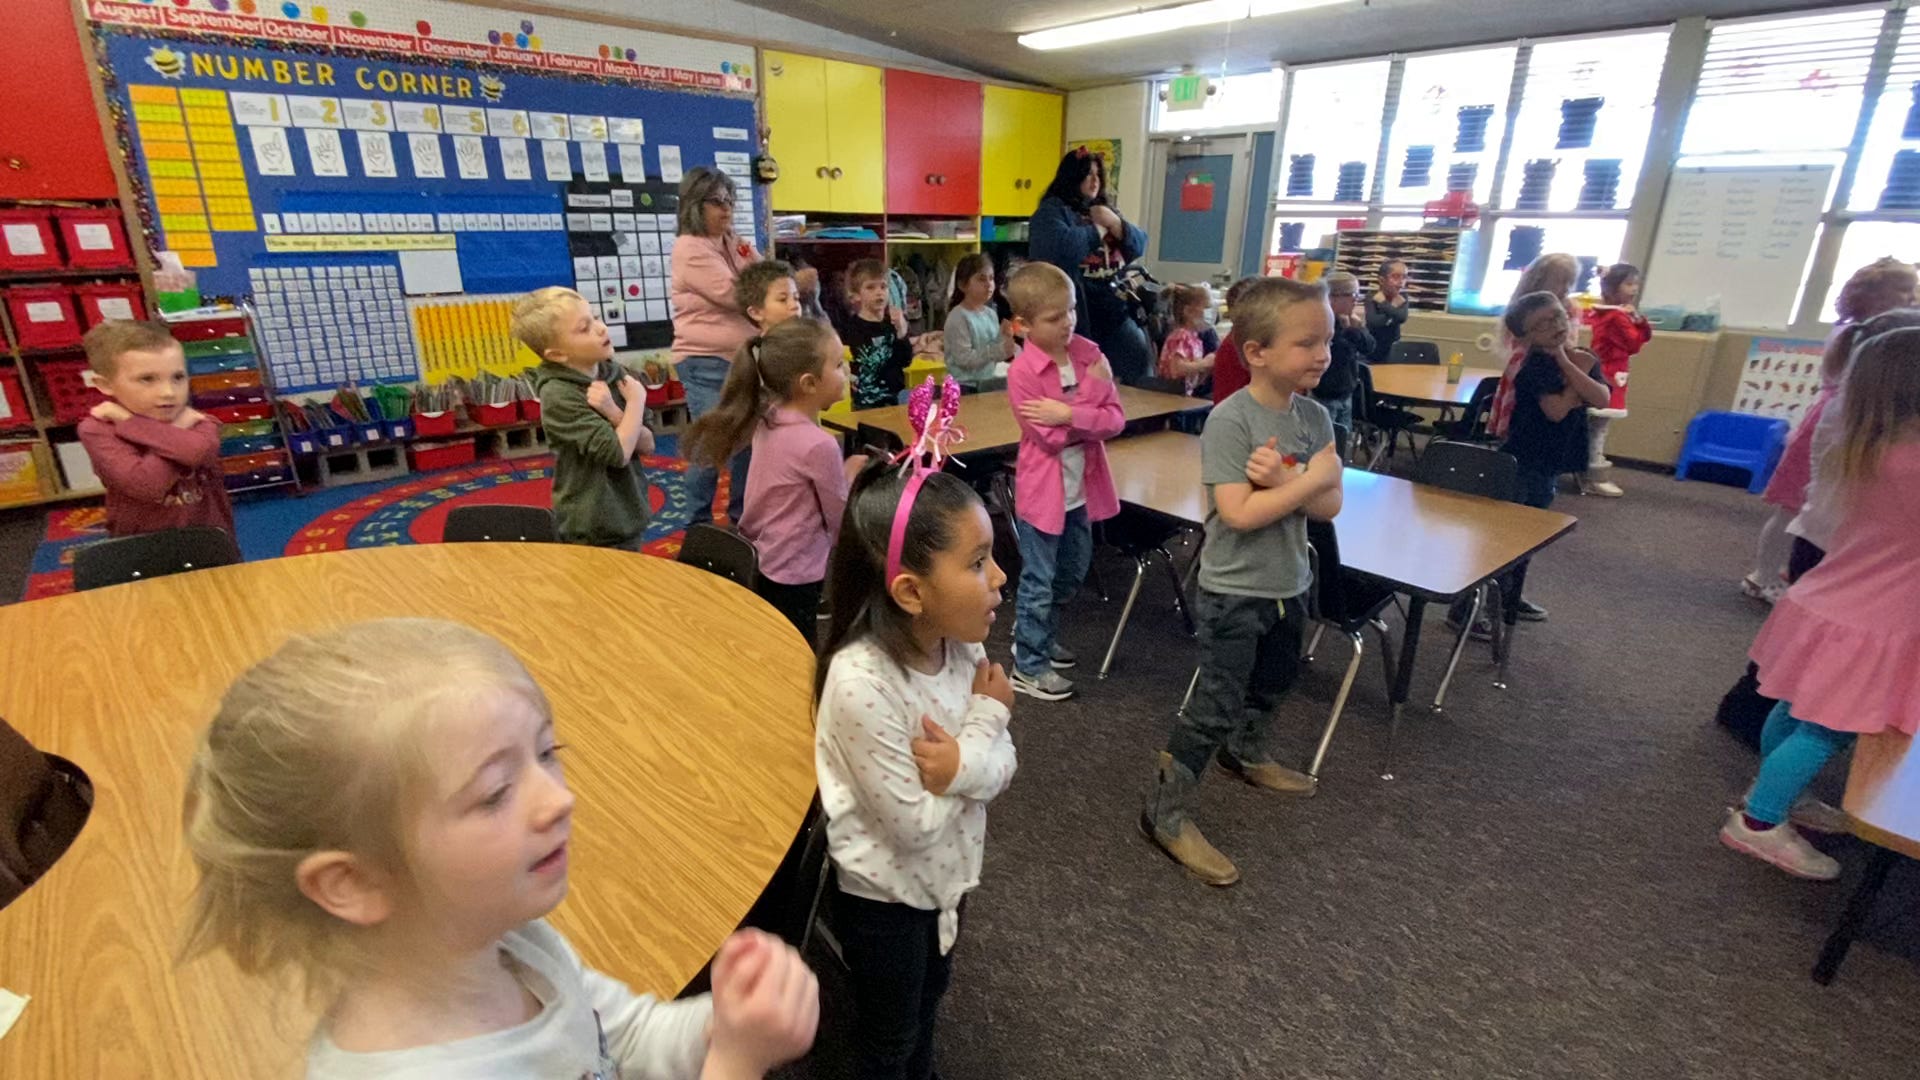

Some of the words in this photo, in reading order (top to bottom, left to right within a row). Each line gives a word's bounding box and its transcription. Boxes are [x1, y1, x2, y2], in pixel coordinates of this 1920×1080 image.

[94, 2, 157, 21] August
[169, 9, 260, 32] September
[266, 21, 330, 40] October
[339, 29, 413, 49] November
[422, 39, 489, 58] December
[495, 49, 542, 66] January
[550, 54, 598, 72] February
[604, 62, 638, 76] March
[643, 66, 666, 79] April
[191, 51, 336, 86] NUMBER
[355, 66, 473, 98] CORNER
[673, 70, 694, 83] May
[700, 73, 721, 85] June
[269, 96, 280, 122] 1
[320, 98, 338, 124] 2
[370, 101, 387, 126] 3
[422, 107, 439, 130] 4
[468, 110, 485, 133] 5
[512, 114, 529, 136] 6
